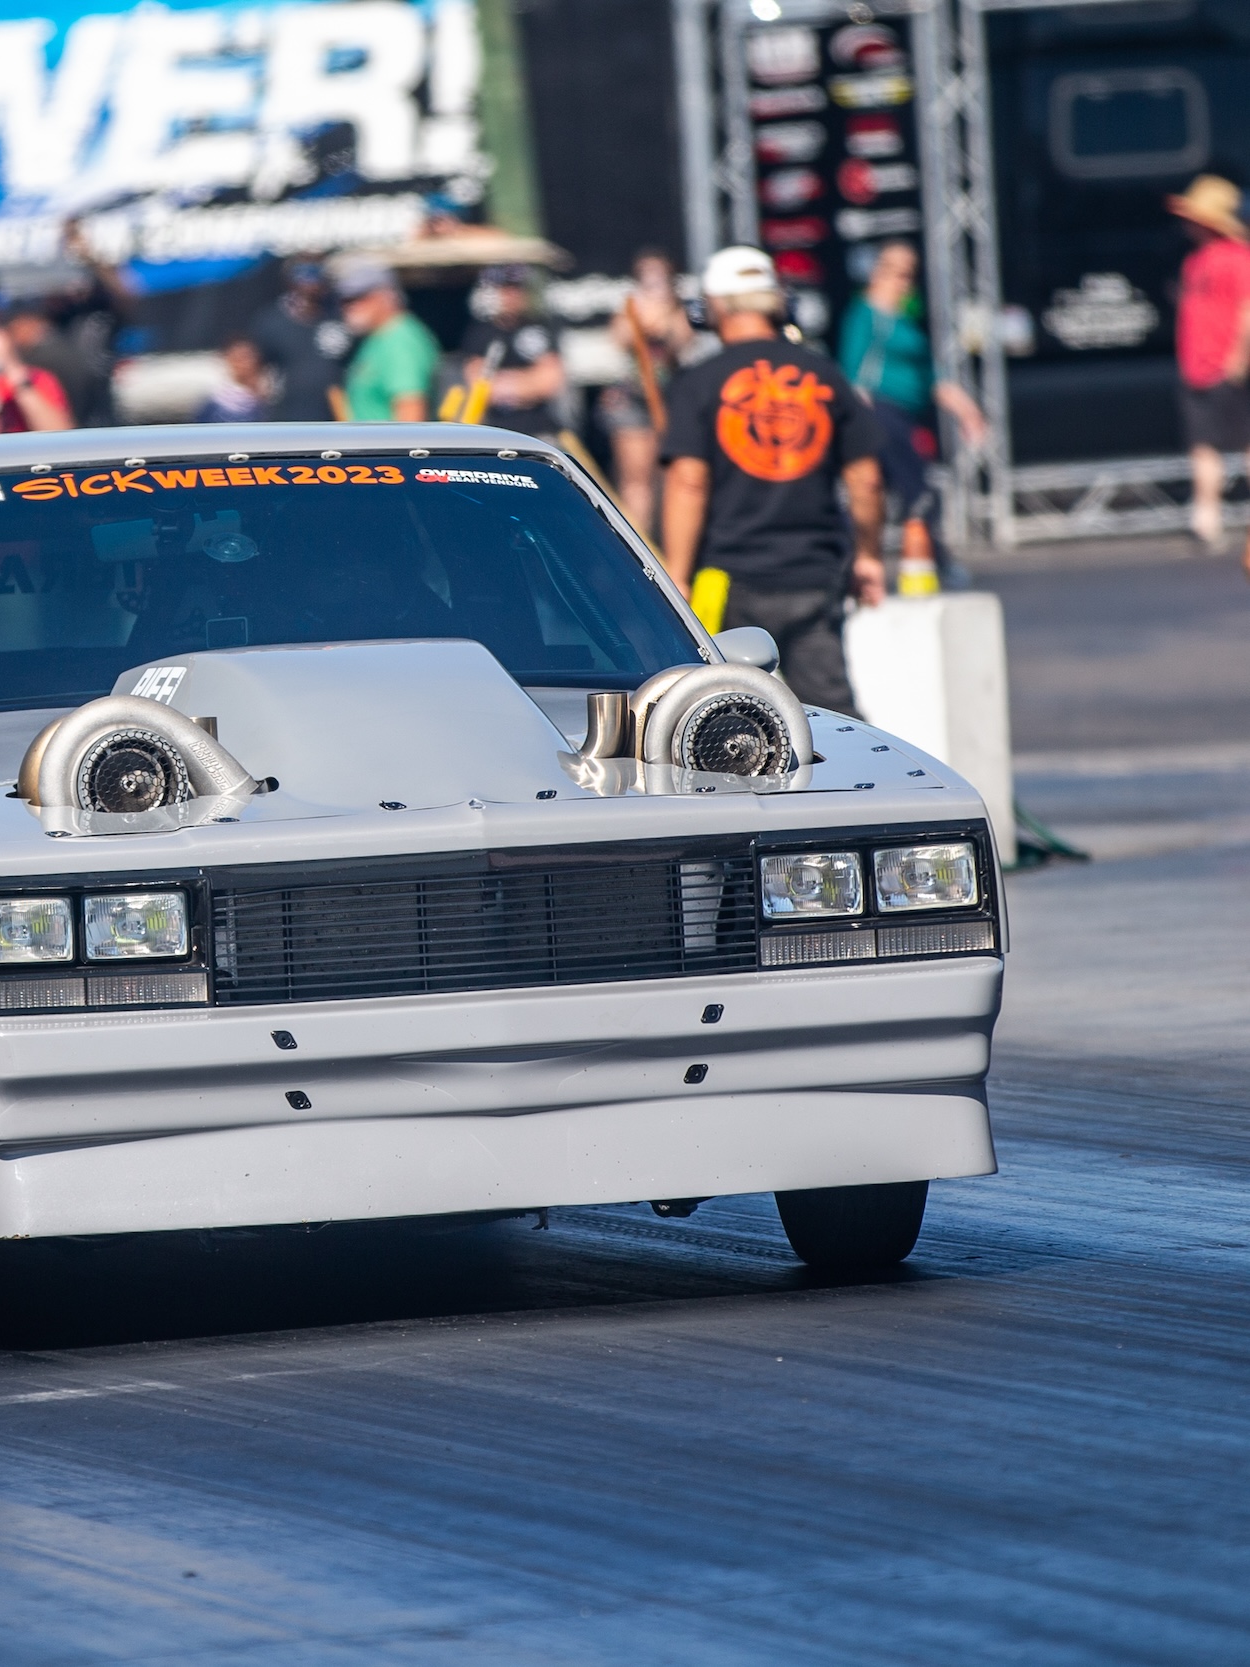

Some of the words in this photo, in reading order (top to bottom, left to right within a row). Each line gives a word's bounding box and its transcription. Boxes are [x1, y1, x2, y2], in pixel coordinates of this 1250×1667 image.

[419, 468, 535, 484] OVERDRIVE
[447, 475, 480, 484] GEAR
[481, 477, 539, 490] VENDORS
